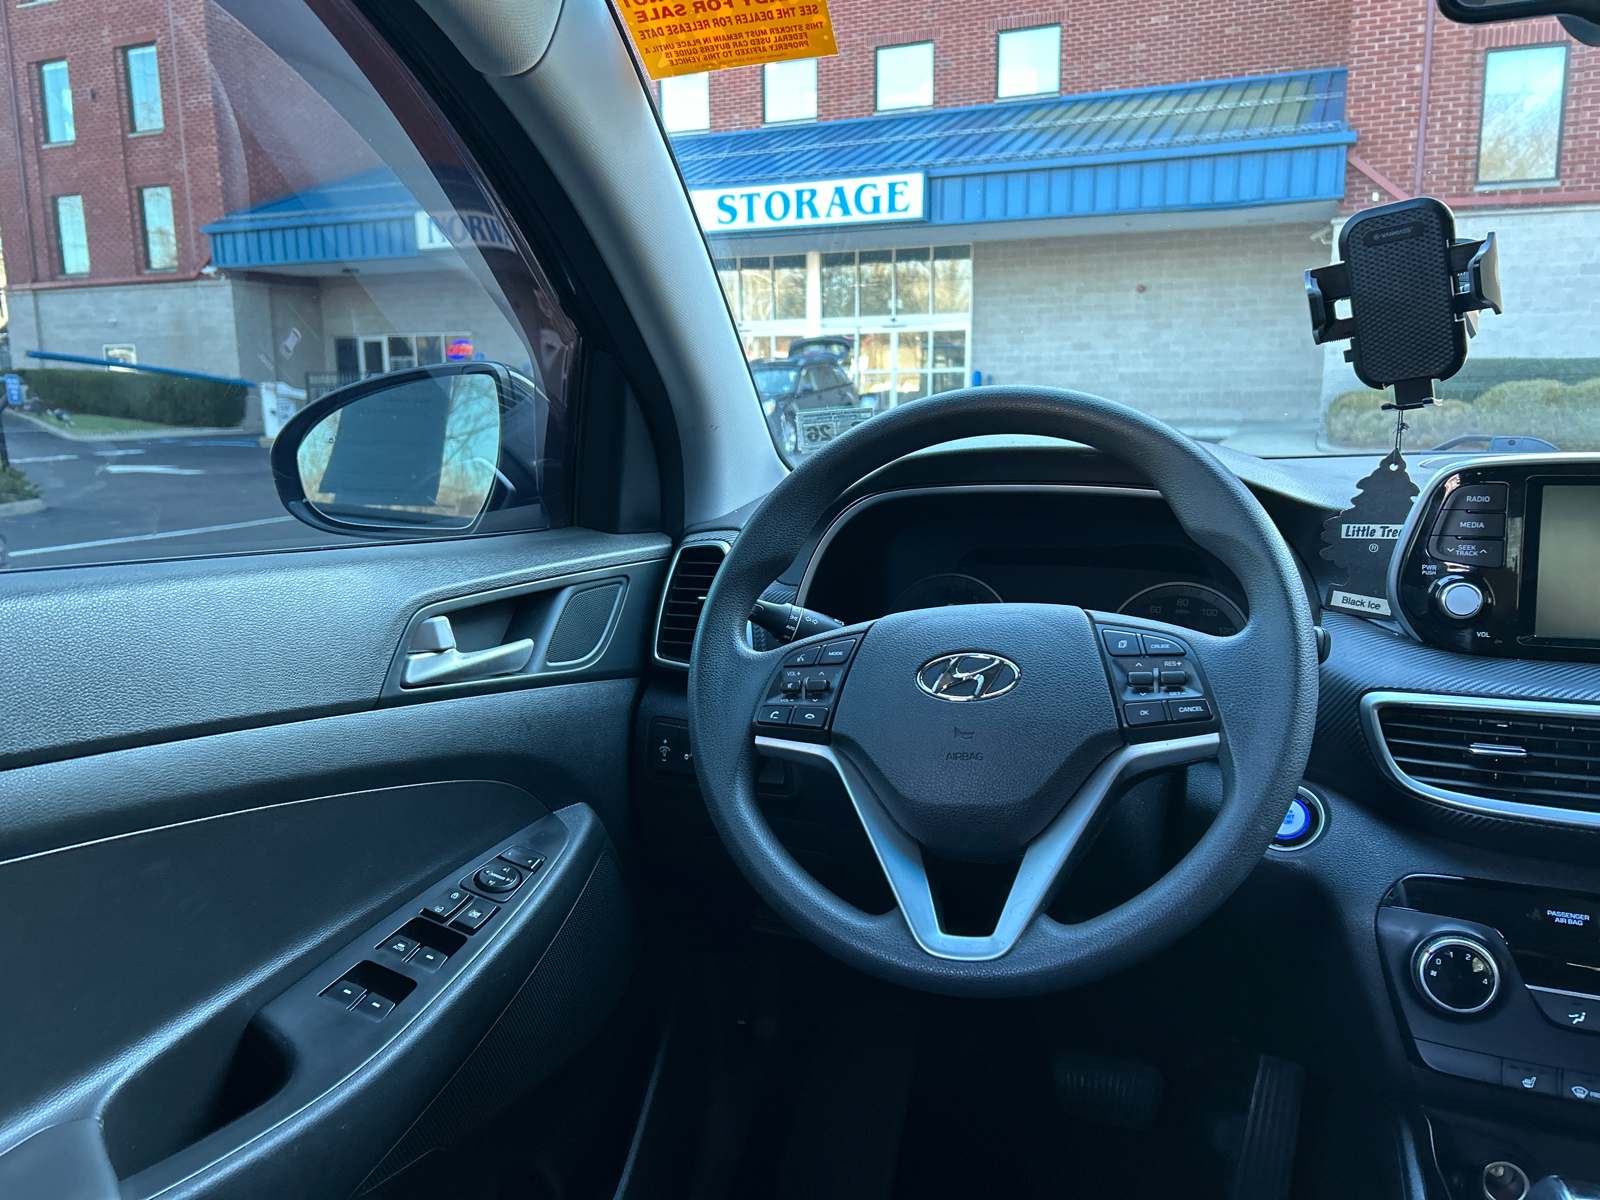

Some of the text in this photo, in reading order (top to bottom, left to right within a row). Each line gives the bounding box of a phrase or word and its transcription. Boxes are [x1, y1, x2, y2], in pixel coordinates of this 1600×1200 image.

[717, 181, 910, 225] STORAGE
[1345, 525, 1376, 537] Little
[1342, 596, 1380, 610] Black Ice
[1150, 606, 1161, 614] 60
[946, 752, 983, 761] AIRBAG
[1547, 910, 1590, 920] PASSENGER
